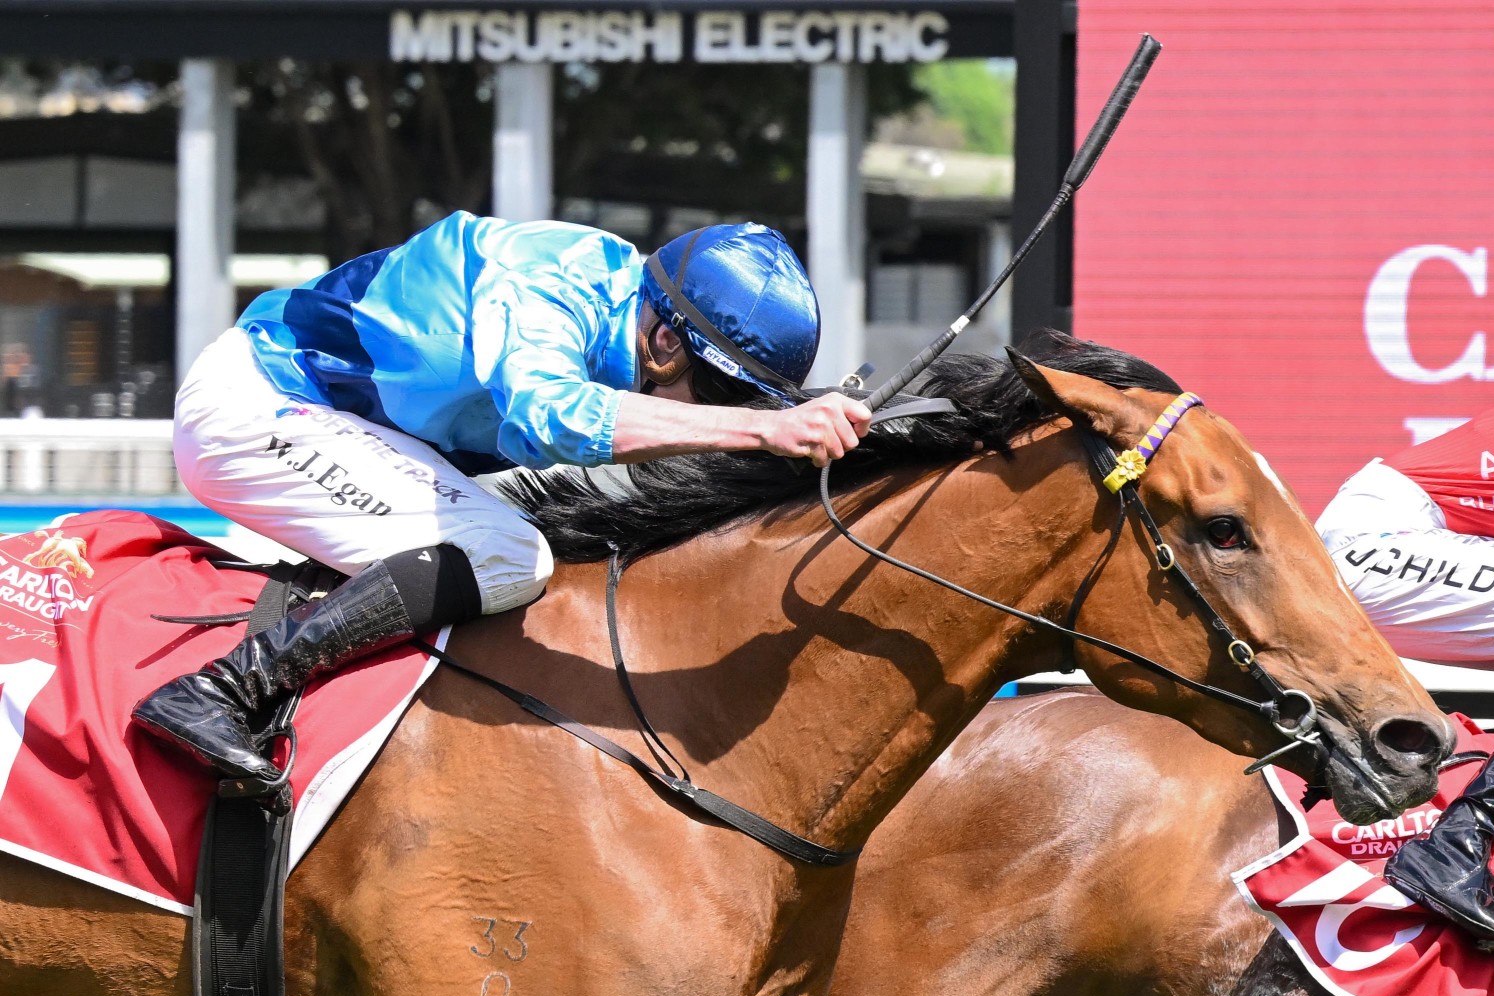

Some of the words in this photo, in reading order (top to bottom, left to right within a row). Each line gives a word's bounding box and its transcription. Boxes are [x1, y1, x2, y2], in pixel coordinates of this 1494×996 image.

[390, 11, 682, 63] MITSUBISHI
[694, 12, 949, 64] ELECTRIC
[706, 350, 736, 372] HYLAND
[469, 915, 534, 962] 33
